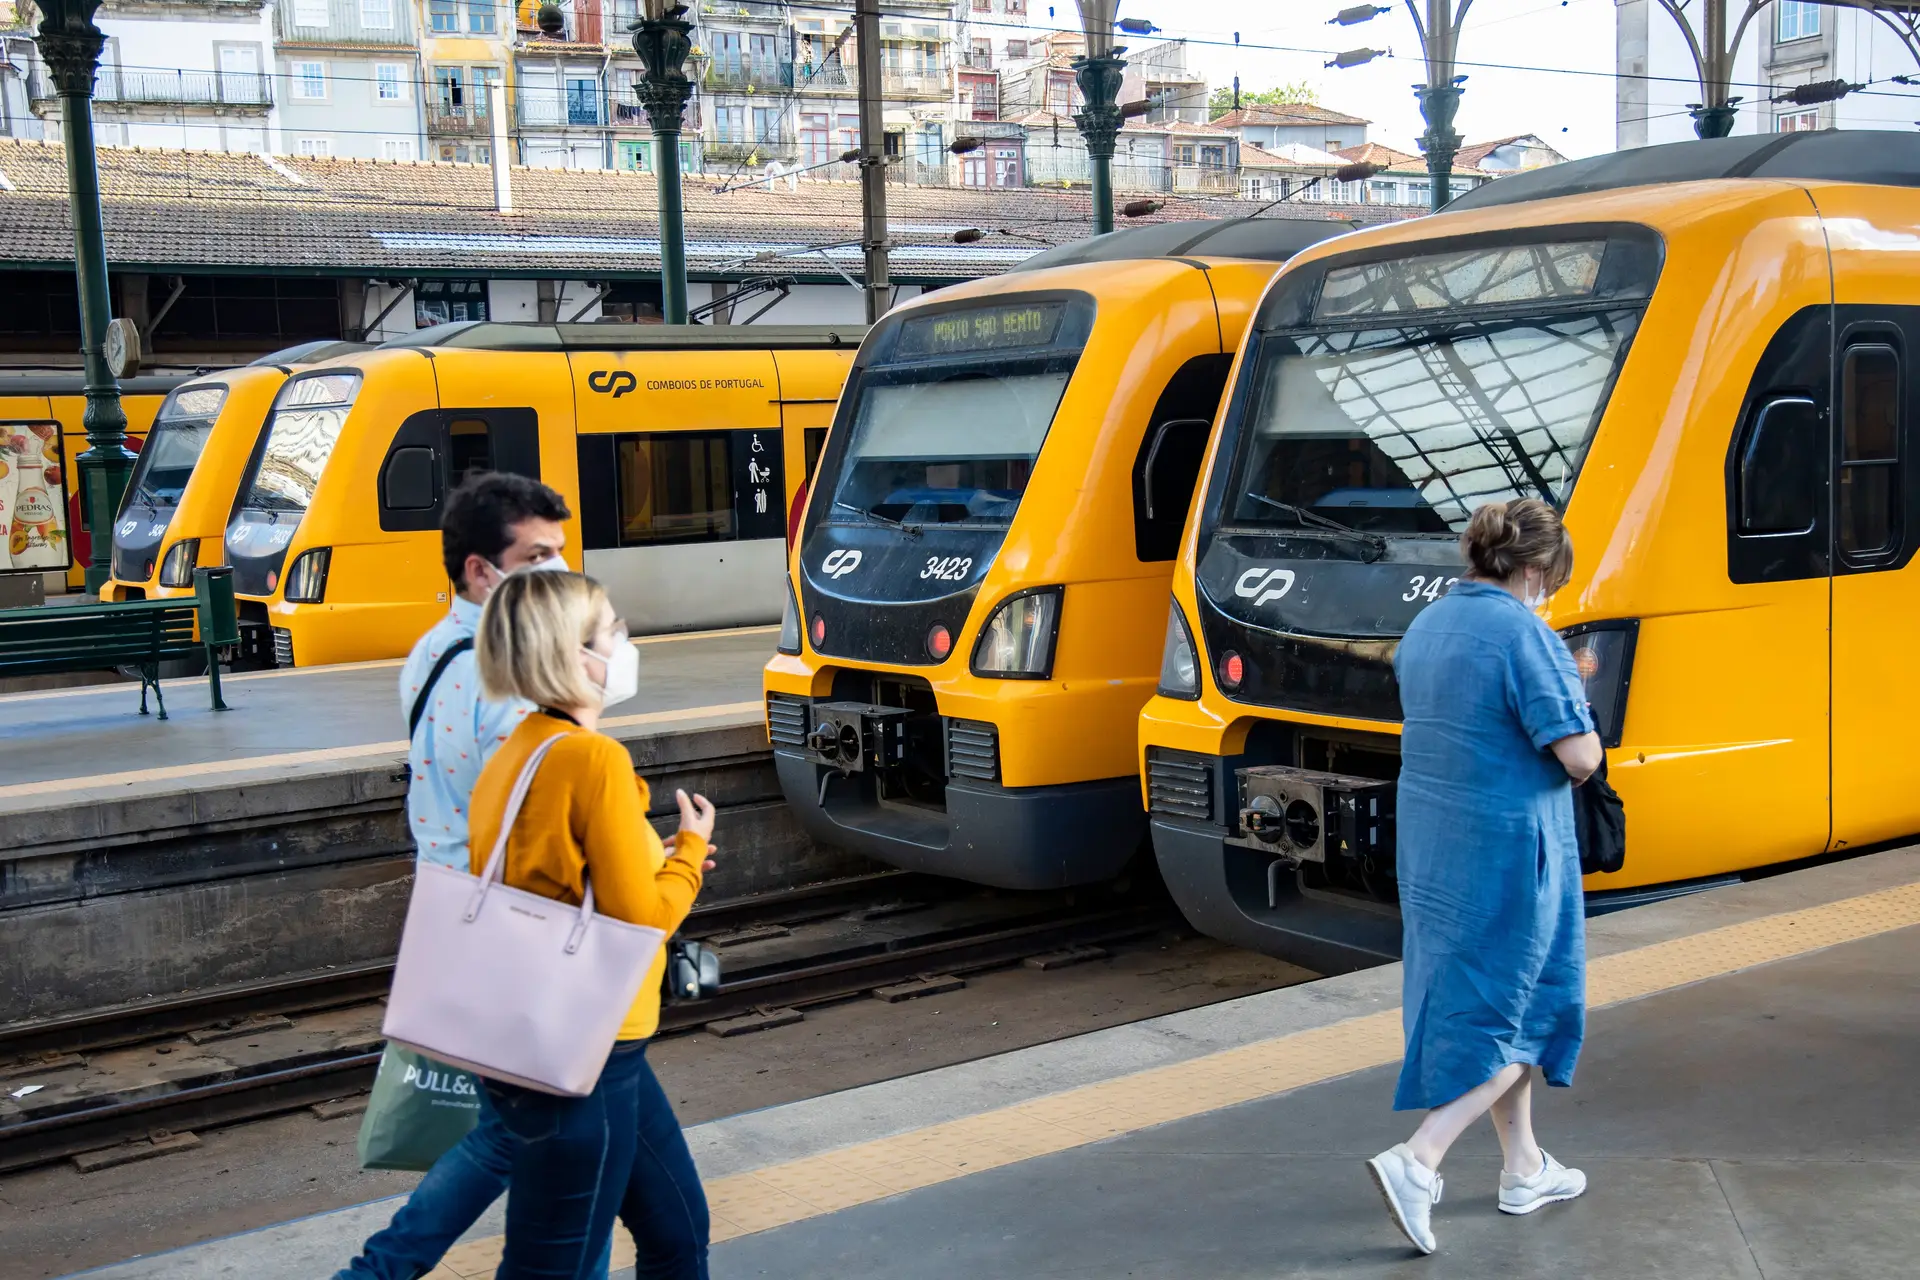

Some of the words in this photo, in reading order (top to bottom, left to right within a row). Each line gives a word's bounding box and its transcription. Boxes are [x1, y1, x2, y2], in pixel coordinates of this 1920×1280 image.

[646, 380, 697, 391] COMBOIOS
[700, 380, 712, 389] DE
[715, 378, 765, 389] PORTUGAL
[15, 504, 52, 512] PEDRAS
[920, 556, 973, 581] 3423
